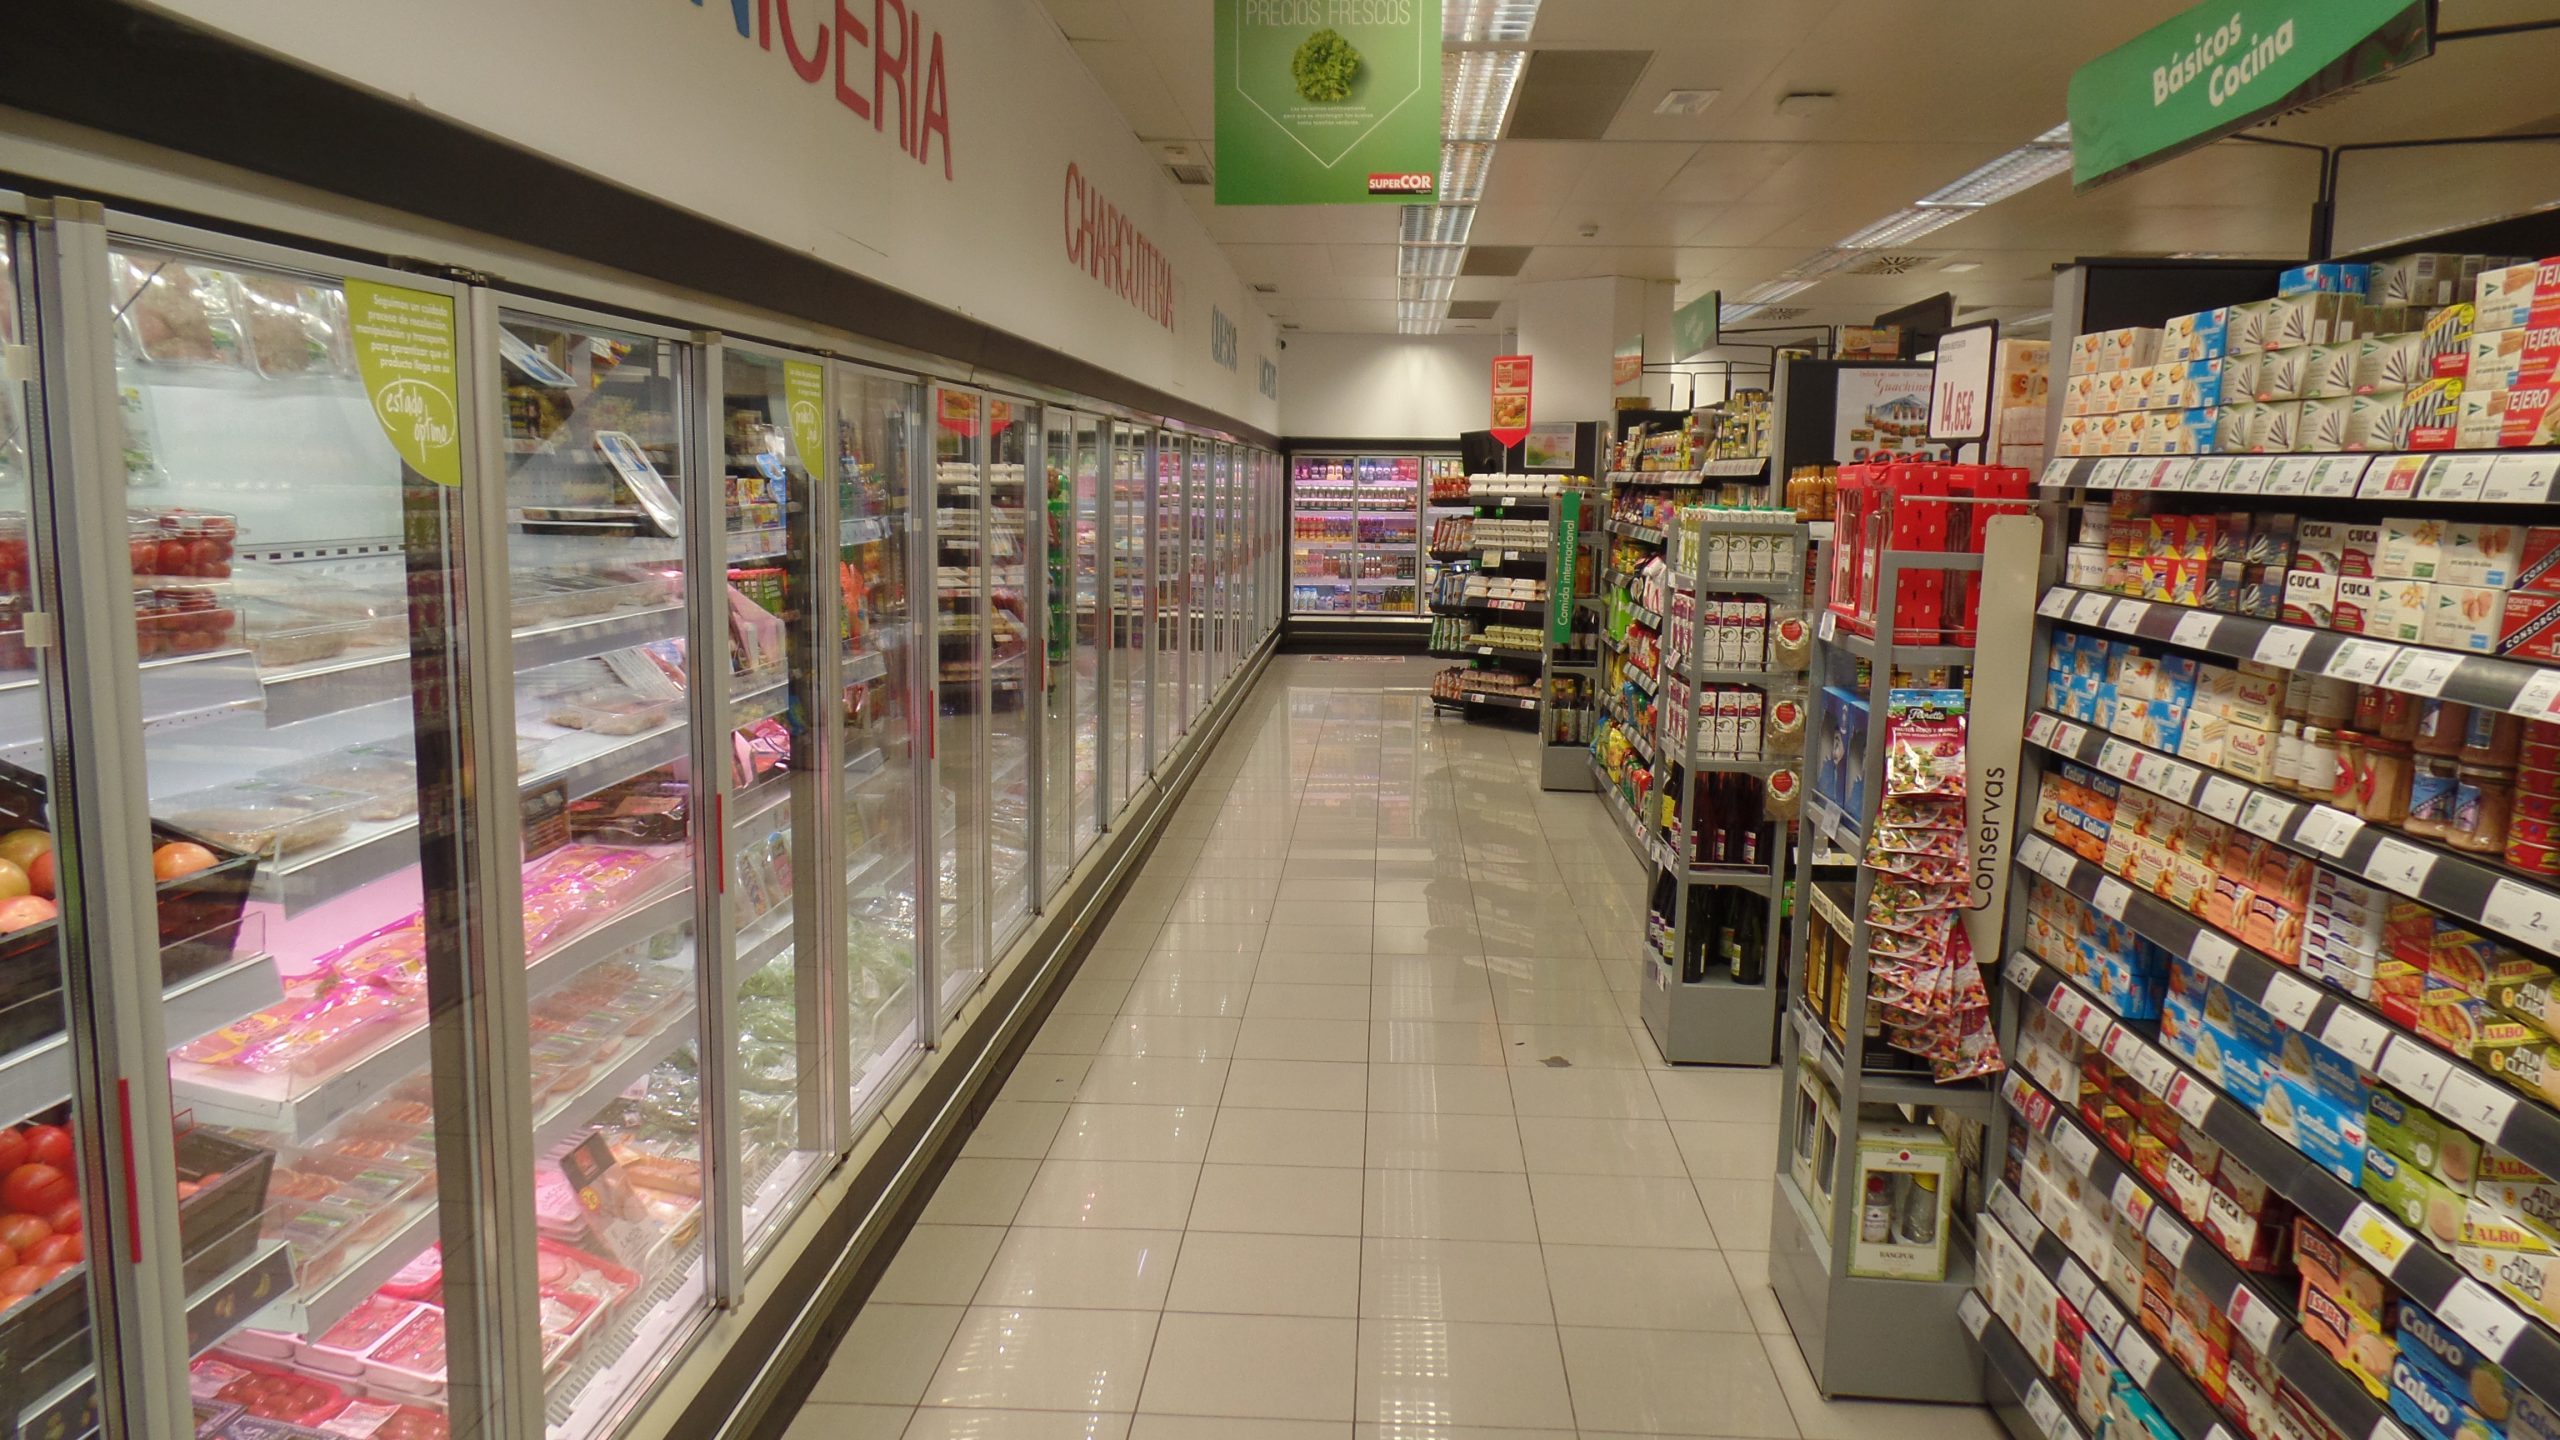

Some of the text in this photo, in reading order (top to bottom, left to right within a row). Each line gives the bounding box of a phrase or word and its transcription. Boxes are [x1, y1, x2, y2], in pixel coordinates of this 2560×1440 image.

[1246, 0, 1411, 26] PRECIOS FRESCOS
[2153, 12, 2242, 106] Básicos
[2208, 19, 2294, 106] Cocina
[690, 0, 952, 181] CERIA
[1369, 175, 1431, 189] SUPERCOR
[1064, 161, 1174, 334] CHARCUTERIA
[371, 342, 389, 352] para
[429, 350, 441, 360] que
[380, 356, 412, 368] producto
[386, 374, 423, 417] estado
[1874, 379, 1932, 397] Guachine
[2507, 389, 2550, 412] TEJERO
[1941, 381, 1974, 436] 14,65€
[414, 404, 447, 463] óptimo
[2302, 524, 2332, 538] CUCA
[2348, 529, 2378, 543] CUCA
[1558, 520, 1575, 626] Comida internacional
[2289, 575, 2320, 589] CUCA
[2341, 583, 2371, 597] CUCA
[1969, 767, 2005, 911] Conservas
[2487, 1027, 2524, 1039] ALBO
[2171, 1158, 2195, 1185] CUCA
[2213, 1192, 2238, 1222] CUCA
[2478, 1228, 2521, 1244] ALBO
[2308, 1291, 2348, 1339] ISABEL
[2400, 1306, 2463, 1366] Calvo
[2231, 1365, 2256, 1395] CUCA
[2394, 1363, 2450, 1425] Calvo
